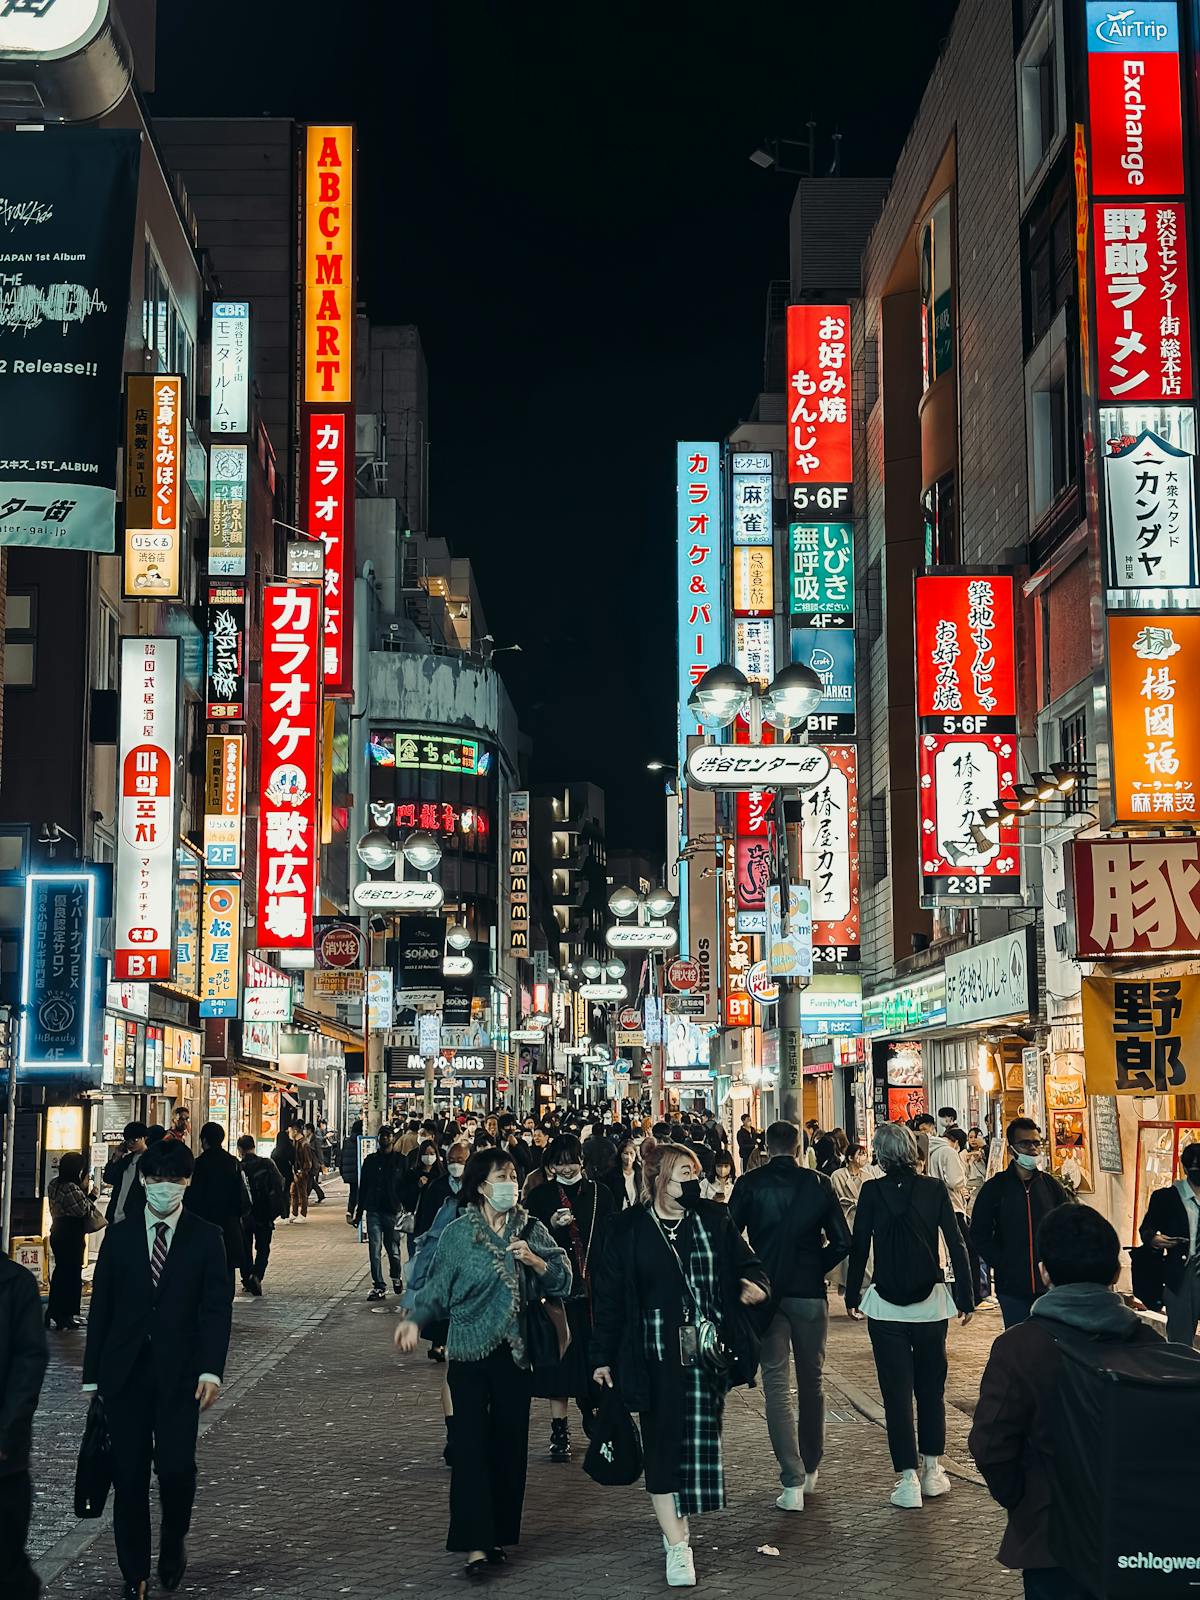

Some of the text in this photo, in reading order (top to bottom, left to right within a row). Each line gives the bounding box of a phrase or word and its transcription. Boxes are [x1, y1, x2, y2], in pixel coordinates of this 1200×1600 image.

[1109, 21, 1168, 41] AirTrip
[1121, 60, 1146, 186] Exchange
[0, 254, 33, 262] JAPAN
[53, 253, 86, 261] Album
[216, 304, 245, 316] CBR
[1104, 208, 1150, 396] 野郎ラーメン
[1156, 209, 1182, 395] 渋谷センター街 総本店
[13, 359, 98, 377] Release!!
[818, 316, 846, 423] お好み焼
[221, 422, 237, 430] 5F
[791, 370, 820, 474] もんじゃ
[156, 385, 175, 525] 全身もみほぐし
[760, 476, 771, 484] 5F
[743, 486, 762, 533] 麻雀
[1166, 471, 1179, 547] 大衆スタンド
[1135, 471, 1162, 577] カンダヤ
[135, 537, 169, 547] りらくる
[138, 552, 165, 562] 渋谷店
[793, 526, 820, 601] 無呼吸
[823, 526, 850, 600] いびき
[221, 563, 235, 573] 4F
[216, 589, 238, 597] ROCK
[794, 602, 850, 612] ご相談ください
[809, 614, 832, 628] 4F
[968, 581, 997, 711] 築地もんじゃ
[932, 620, 962, 711] お好み焼
[817, 672, 834, 685] aft
[211, 705, 238, 717] 3F
[1140, 666, 1180, 775] 楊國福
[807, 715, 839, 731] B1F
[399, 738, 461, 765] 金ちゃん
[265, 587, 311, 938] カラオケ 歌広場
[696, 757, 822, 773] 渋谷センター街
[1131, 781, 1193, 790] マーラータン
[135, 751, 159, 842] 마약포차
[211, 847, 234, 862] 2F
[808, 785, 841, 904] 椿屋カフェ
[1090, 842, 1200, 950] 豚
[209, 918, 231, 963] 松屋
[326, 941, 357, 956] 消火栓
[128, 955, 157, 976] B1
[672, 970, 697, 982] 消火栓
[730, 999, 749, 1016] B1
[809, 998, 858, 1010] FamilyMart
[1113, 980, 1187, 1092] 野郎
[408, 1054, 484, 1071] Mcoald's
